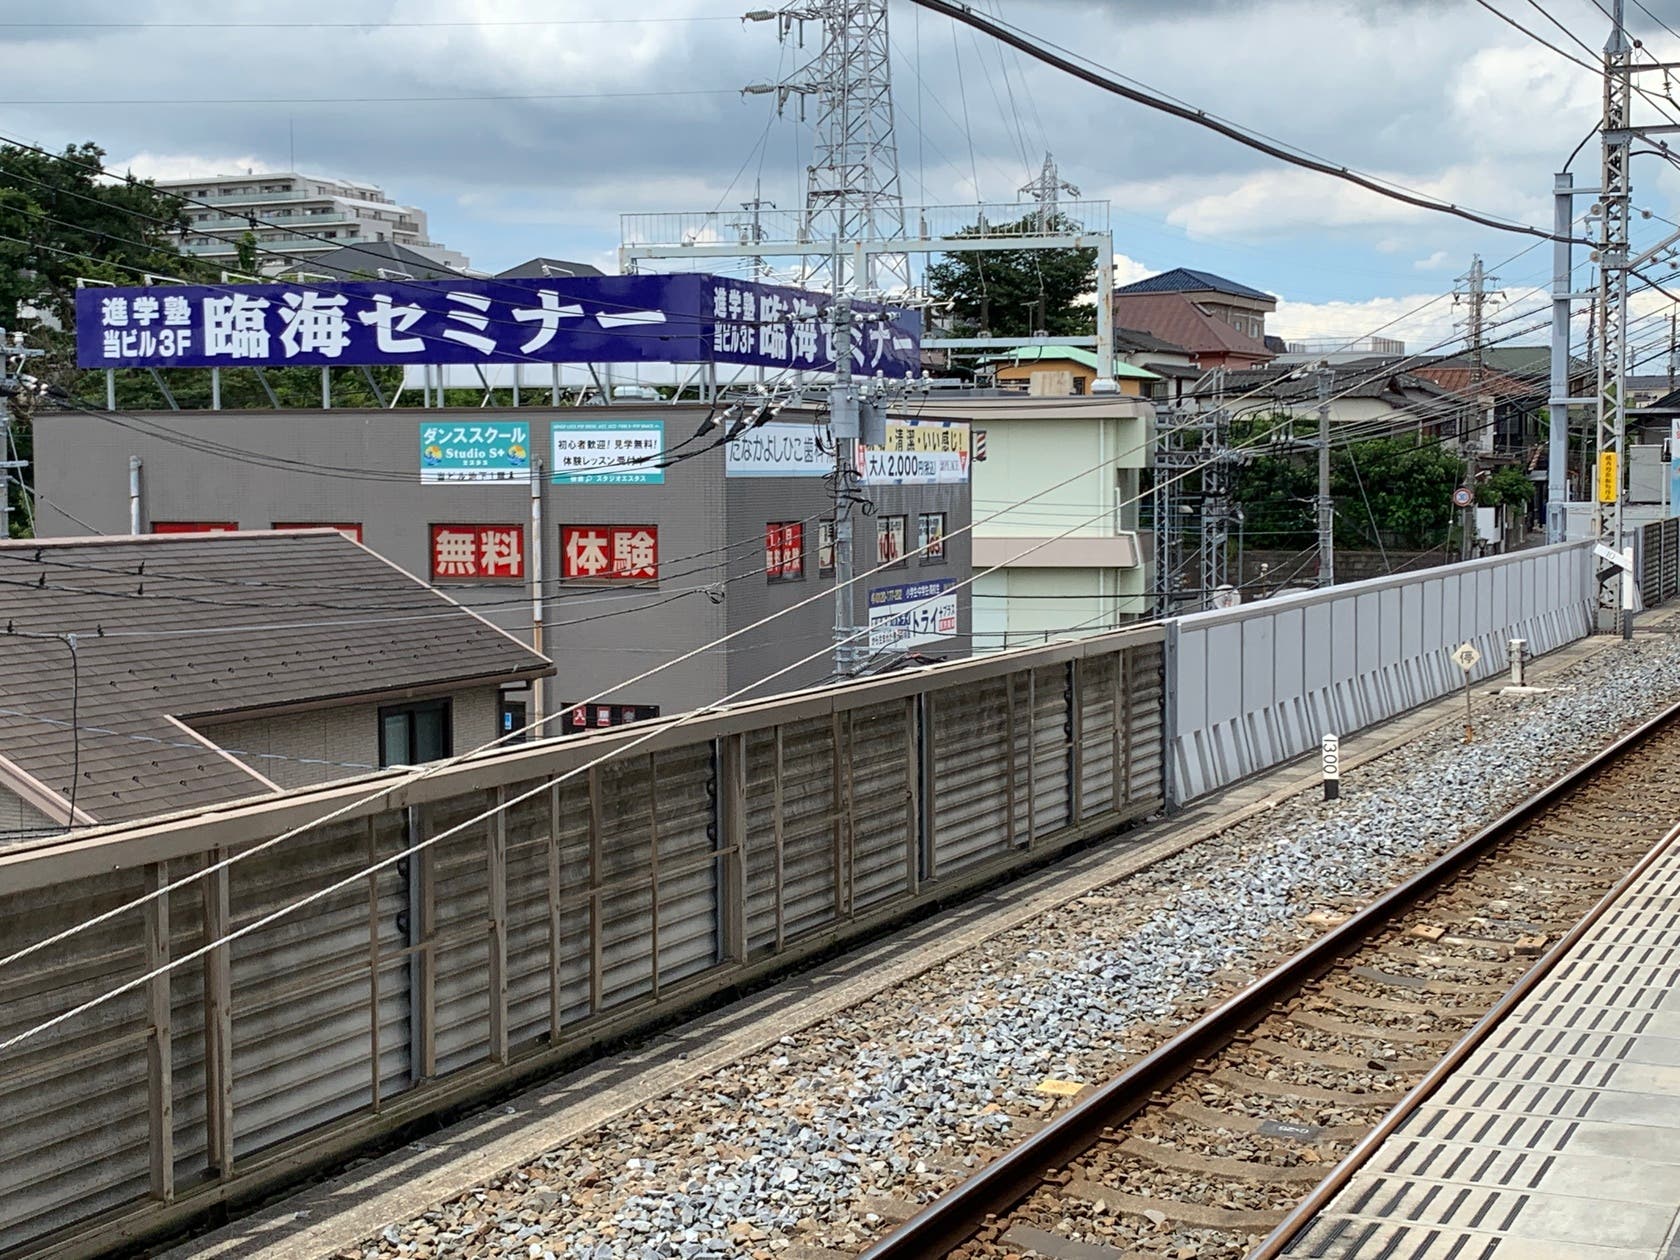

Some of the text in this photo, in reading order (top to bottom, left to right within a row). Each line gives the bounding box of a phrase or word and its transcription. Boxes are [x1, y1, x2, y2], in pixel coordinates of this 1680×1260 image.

[102, 297, 192, 327] 進学塾
[714, 286, 755, 321] 進学塾
[203, 291, 667, 359] 臨海セミナー
[714, 321, 755, 354] 当ビル3F
[102, 329, 192, 359] 当ビル3F
[423, 426, 527, 445] ダンススクール
[614, 440, 657, 450] 見学無料!
[445, 447, 486, 459] Studio
[436, 530, 522, 576] 無料
[566, 530, 656, 577] 体験
[912, 607, 938, 637] トライ
[1459, 650, 1475, 664] 停
[1323, 739, 1338, 774] 1300
